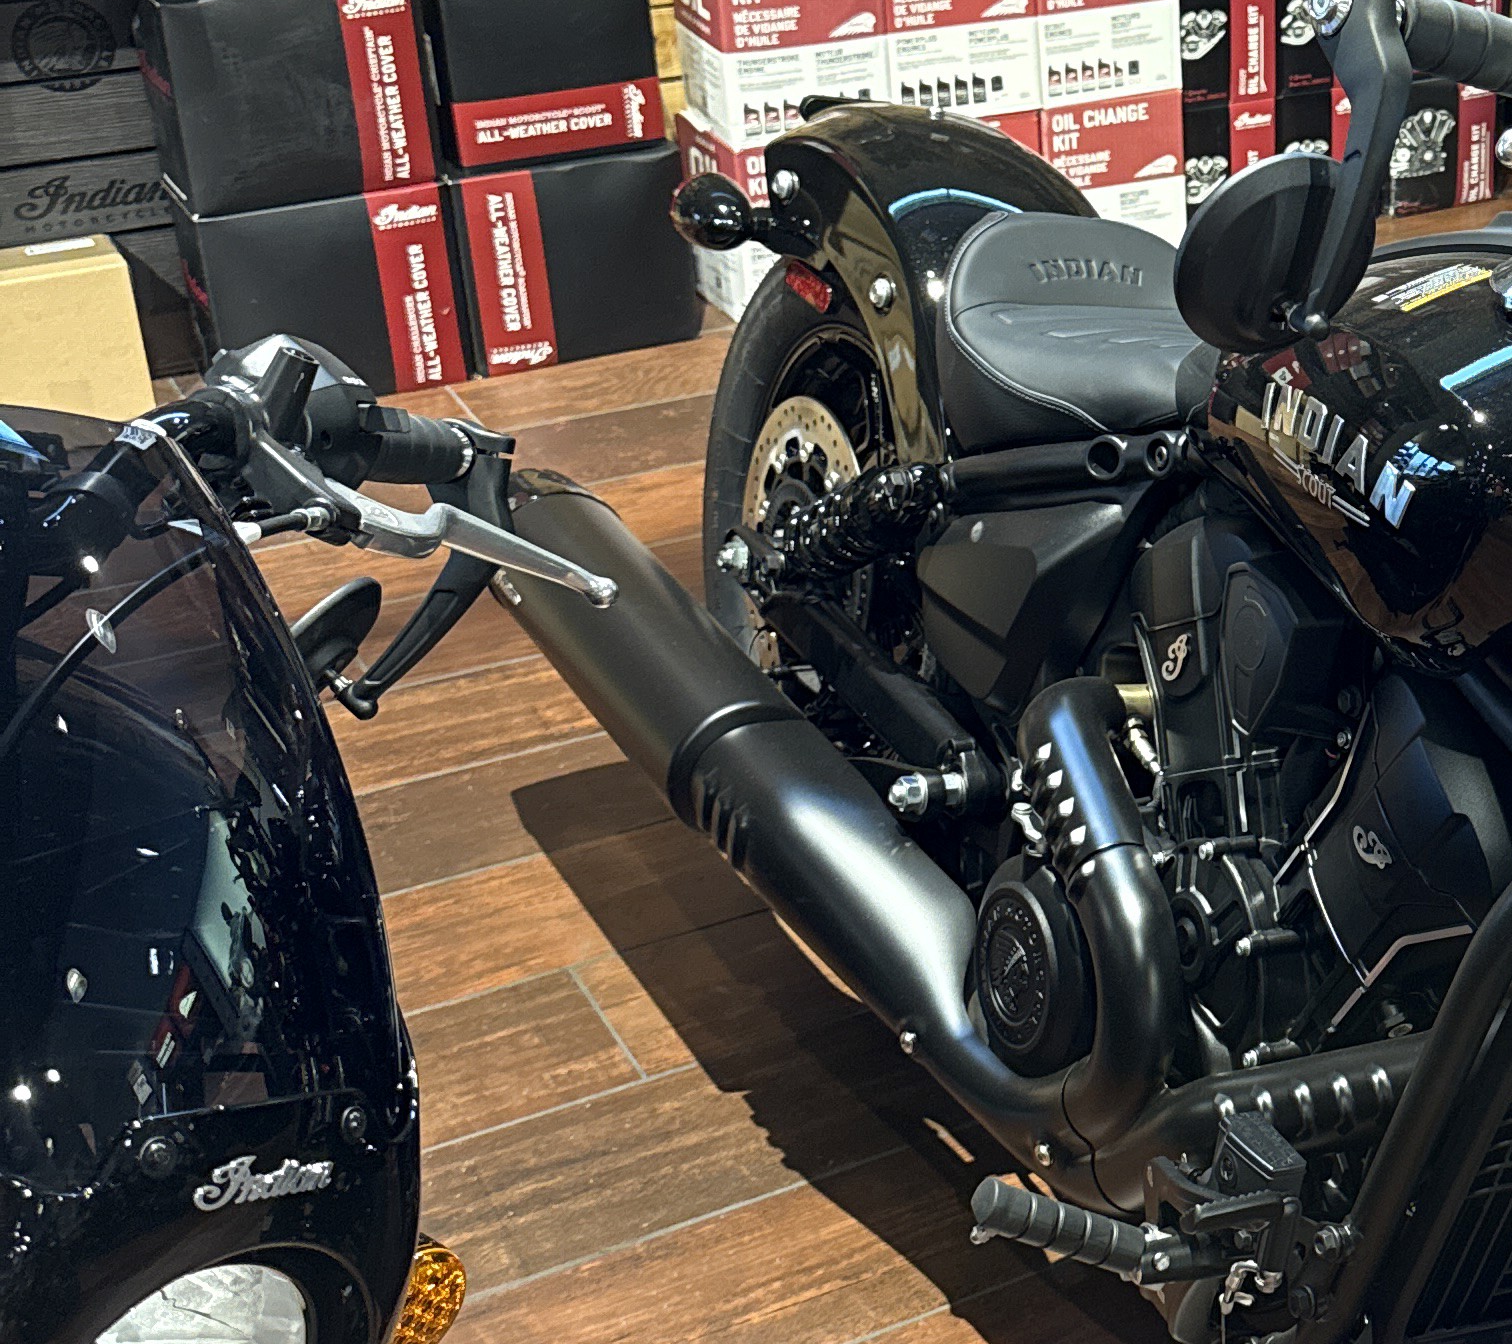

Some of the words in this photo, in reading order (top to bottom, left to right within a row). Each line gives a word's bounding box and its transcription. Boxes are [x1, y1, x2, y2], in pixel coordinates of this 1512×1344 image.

[732, 6, 801, 24] NÉCESSAIRE
[893, 4, 910, 17] DE
[910, 0, 952, 14] VIDANGE
[894, 14, 935, 28] D'HUILE
[1247, 4, 1259, 20] KIT
[734, 24, 750, 37] DE
[752, 19, 799, 35] VIDANGE
[735, 35, 780, 49] D'HUILE
[377, 35, 398, 83] COVER
[1248, 25, 1260, 73] CHANGE
[1247, 75, 1259, 95] OIL
[628, 84, 646, 138] Indian
[1051, 113, 1080, 133] OIL
[1082, 103, 1149, 129] CHANGE
[1234, 112, 1272, 127] Indian
[384, 85, 411, 179] ALL-WEATHER
[477, 120, 568, 144] ALL-WEATHER
[569, 113, 612, 131] COVER
[1052, 132, 1080, 152] KIT
[1471, 124, 1481, 141] KIT
[1470, 143, 1480, 184] CHANGE
[14, 175, 170, 220] Indian
[374, 204, 438, 226] Indian
[406, 244, 429, 290] COVER
[486, 193, 515, 286] ALL-WEATHER
[501, 287, 521, 332] COVER
[1028, 259, 1143, 287] INDIAN
[414, 290, 443, 381] ALL-WEATHER
[490, 346, 553, 366] Indian
[1261, 382, 1416, 529] INDIAN
[194, 1155, 333, 1210] Indian
